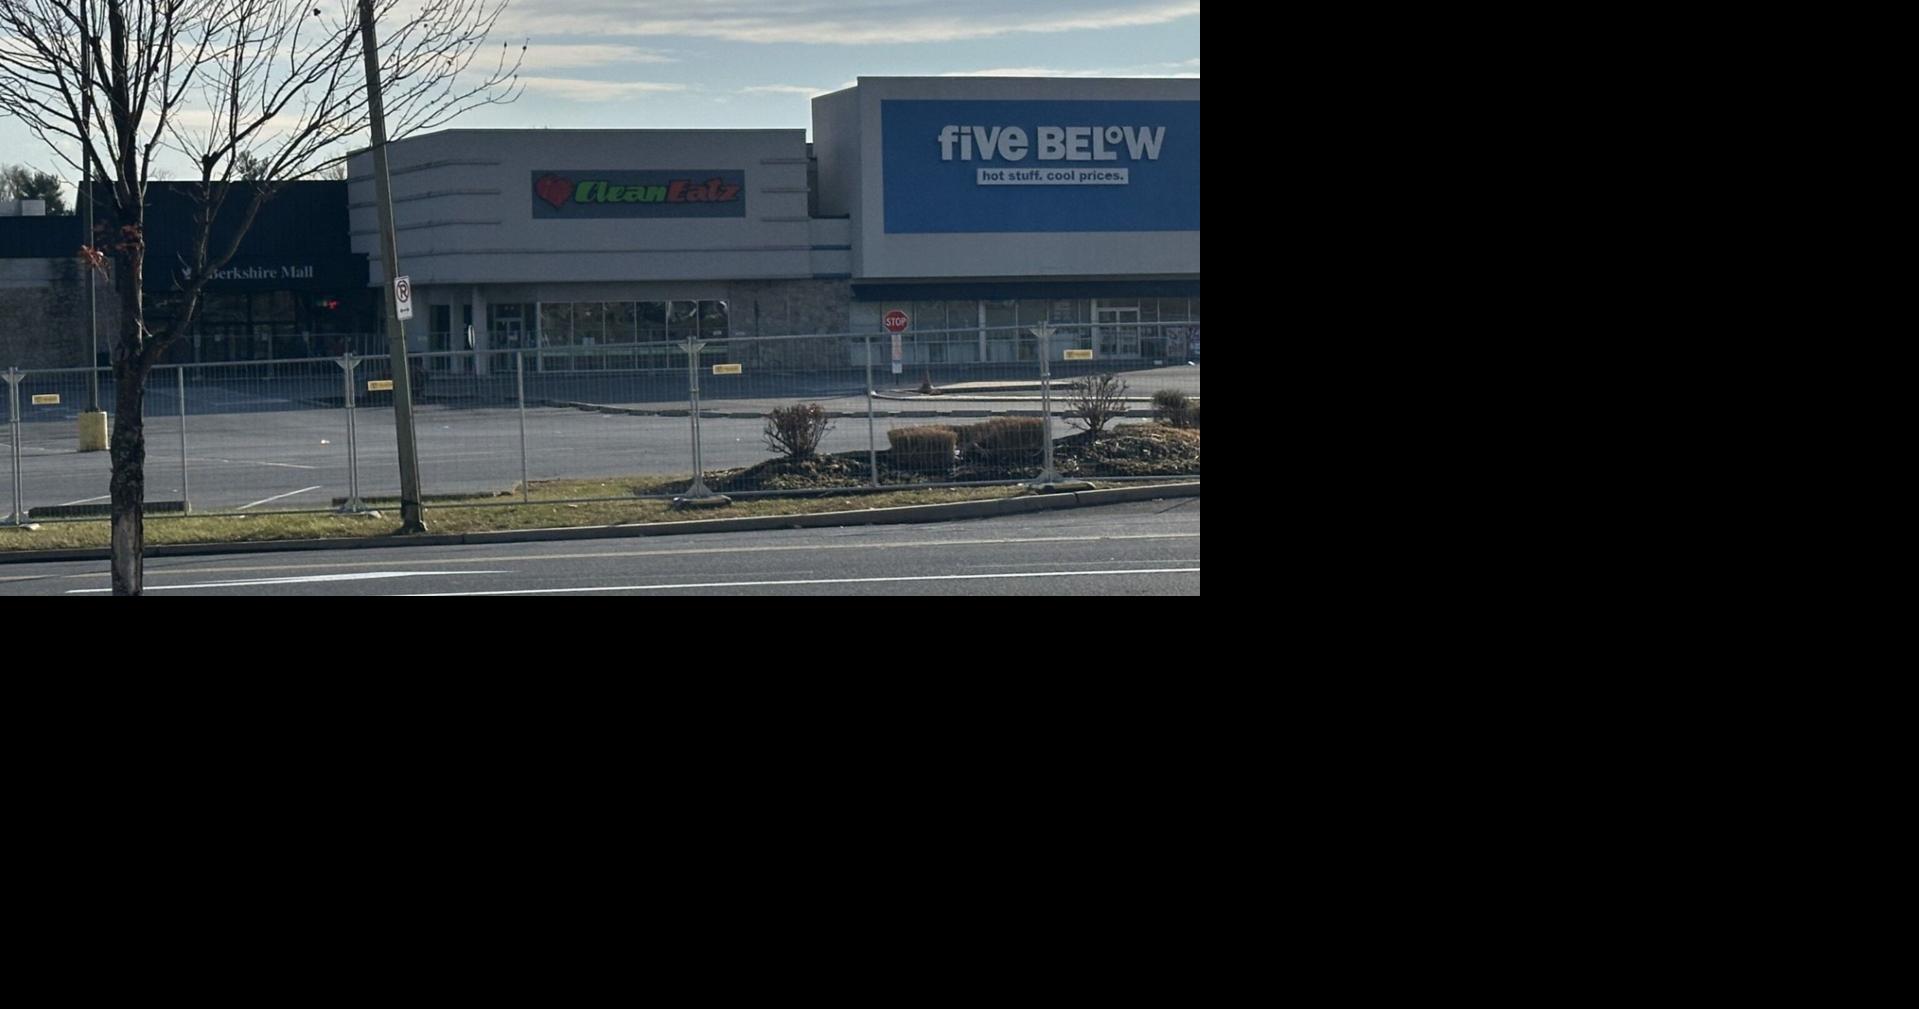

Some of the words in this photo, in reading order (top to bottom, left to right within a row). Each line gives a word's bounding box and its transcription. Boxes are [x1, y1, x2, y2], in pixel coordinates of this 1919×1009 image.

[938, 125, 1029, 161] five
[982, 170, 1004, 181] hot
[1008, 169, 1042, 181] stuff.
[1047, 170, 1075, 181] cool
[1079, 170, 1124, 184] prices.
[281, 265, 313, 279] Mall
[886, 317, 906, 326] STOP
